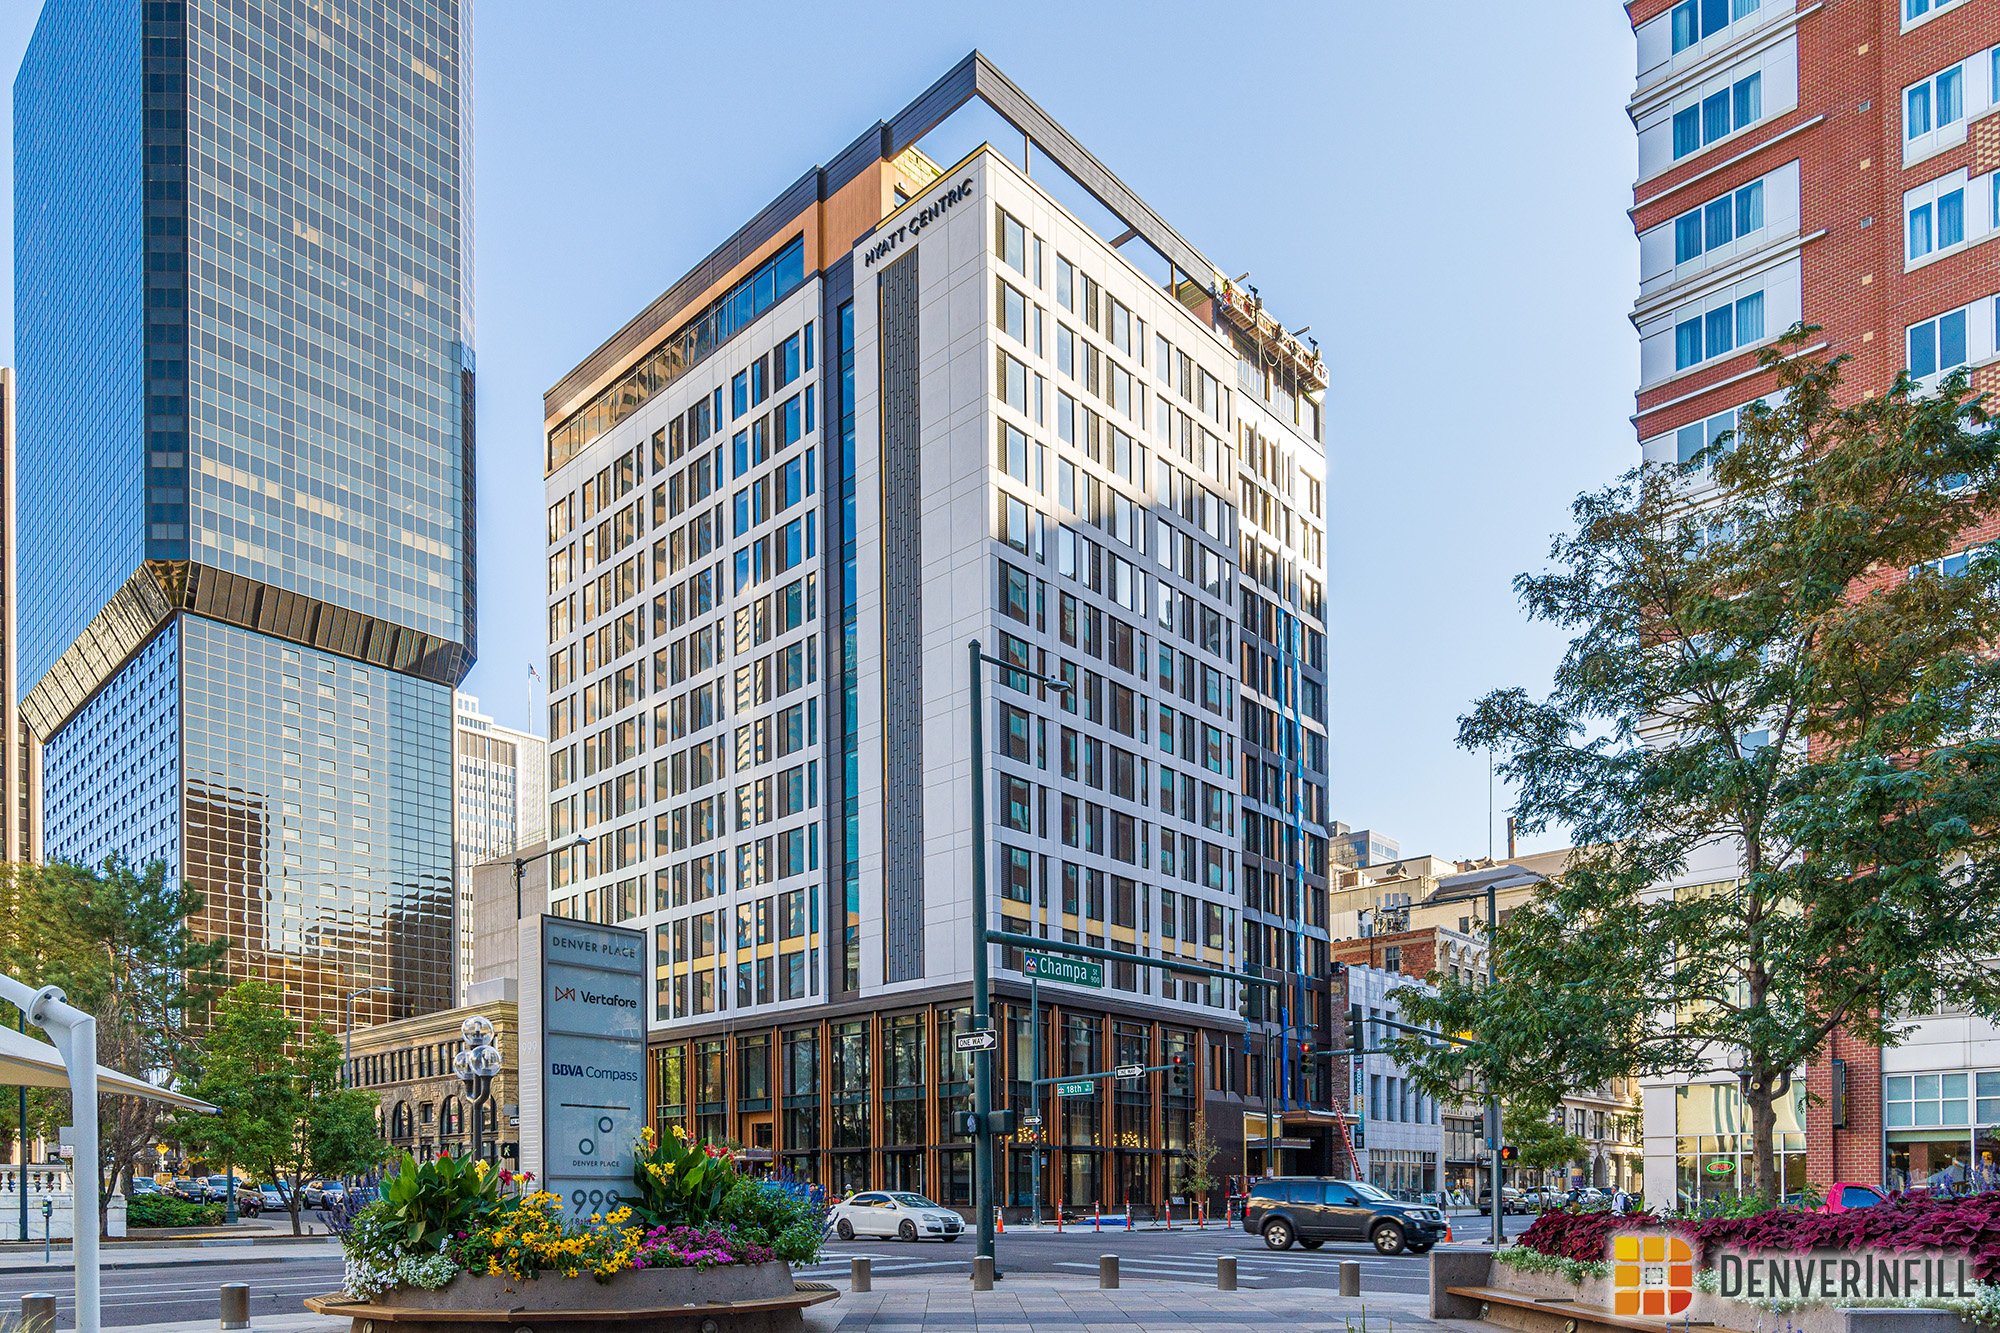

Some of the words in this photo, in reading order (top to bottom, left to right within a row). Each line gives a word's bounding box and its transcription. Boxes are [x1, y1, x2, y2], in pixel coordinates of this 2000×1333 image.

[864, 225, 907, 268] HYATT
[908, 178, 974, 236] CENTRIC
[552, 936, 598, 953] DENVER
[602, 944, 636, 959] PLACE
[1040, 957, 1087, 982] Champa
[1092, 968, 1098, 976] St
[1090, 976, 1100, 984] 900
[580, 990, 637, 1009] Vertafore
[522, 1040, 538, 1056] 999
[959, 1039, 971, 1047] ONE
[972, 1037, 985, 1045] WAY
[552, 1063, 584, 1078] BBVA
[585, 1066, 638, 1081] Compass
[1066, 1084, 1082, 1094] 18th
[571, 1189, 620, 1215] 999
